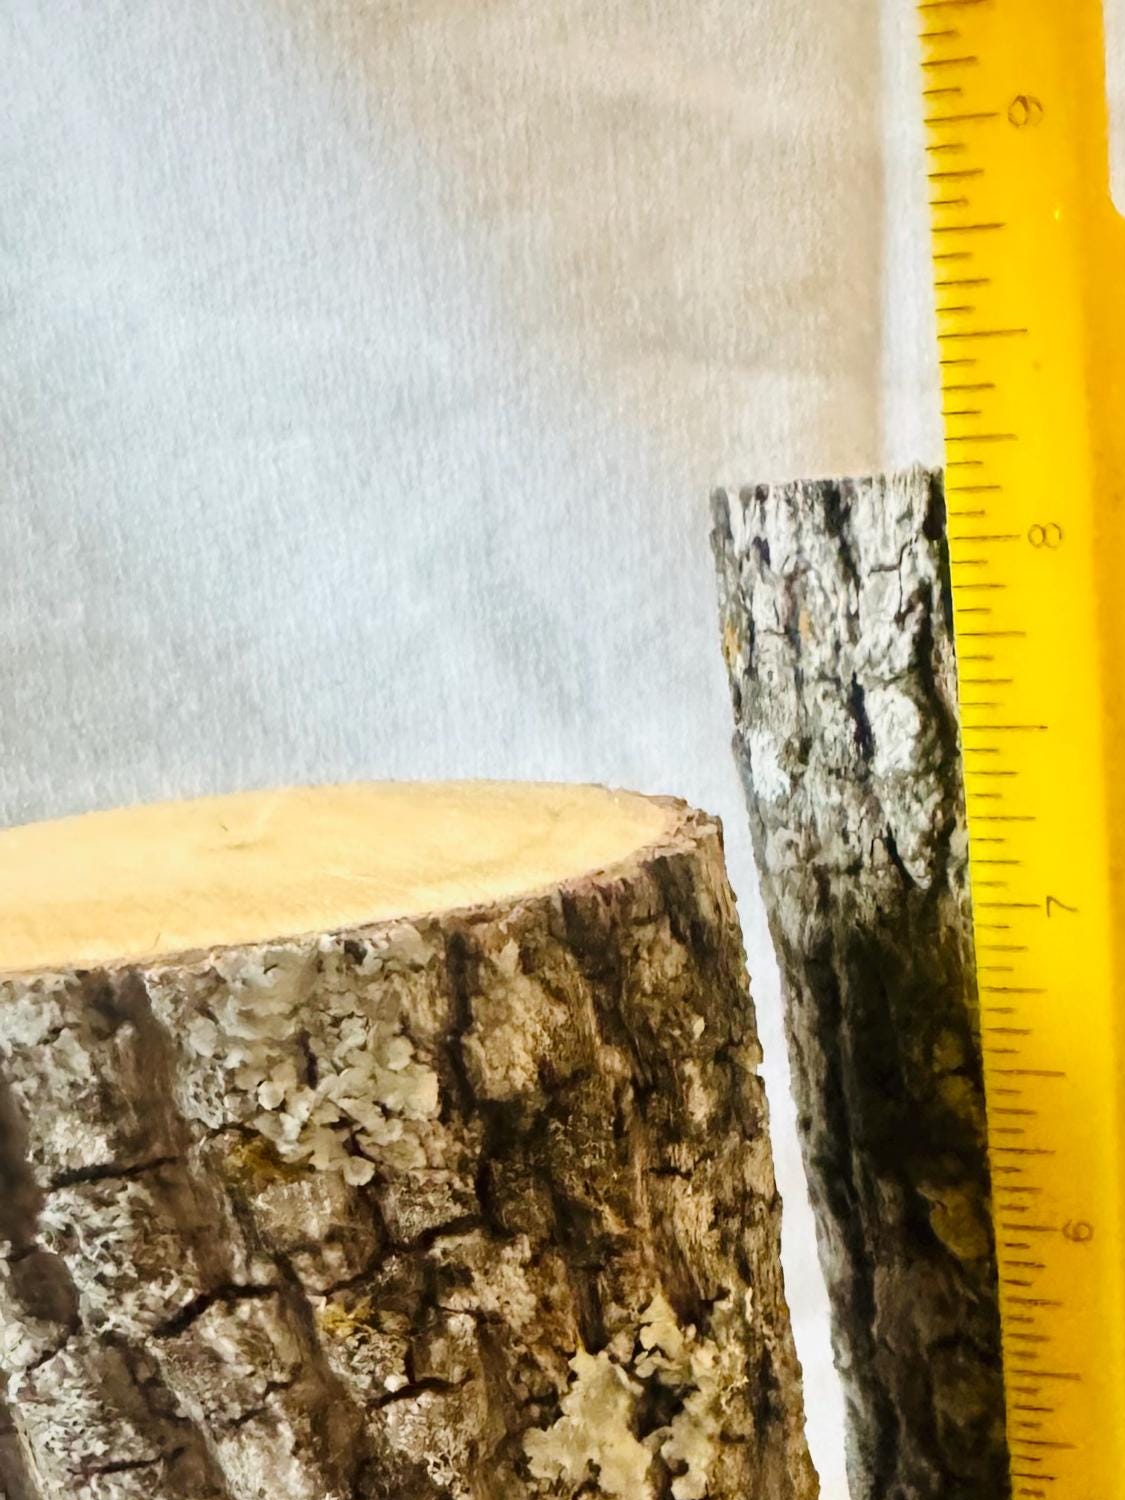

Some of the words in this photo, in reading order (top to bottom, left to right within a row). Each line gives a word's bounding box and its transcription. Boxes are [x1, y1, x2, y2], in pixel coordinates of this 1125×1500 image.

[1007, 94, 1045, 129] 9
[1027, 521, 1063, 549] 8
[1046, 895, 1079, 918] 7
[1061, 1218, 1094, 1243] 6
